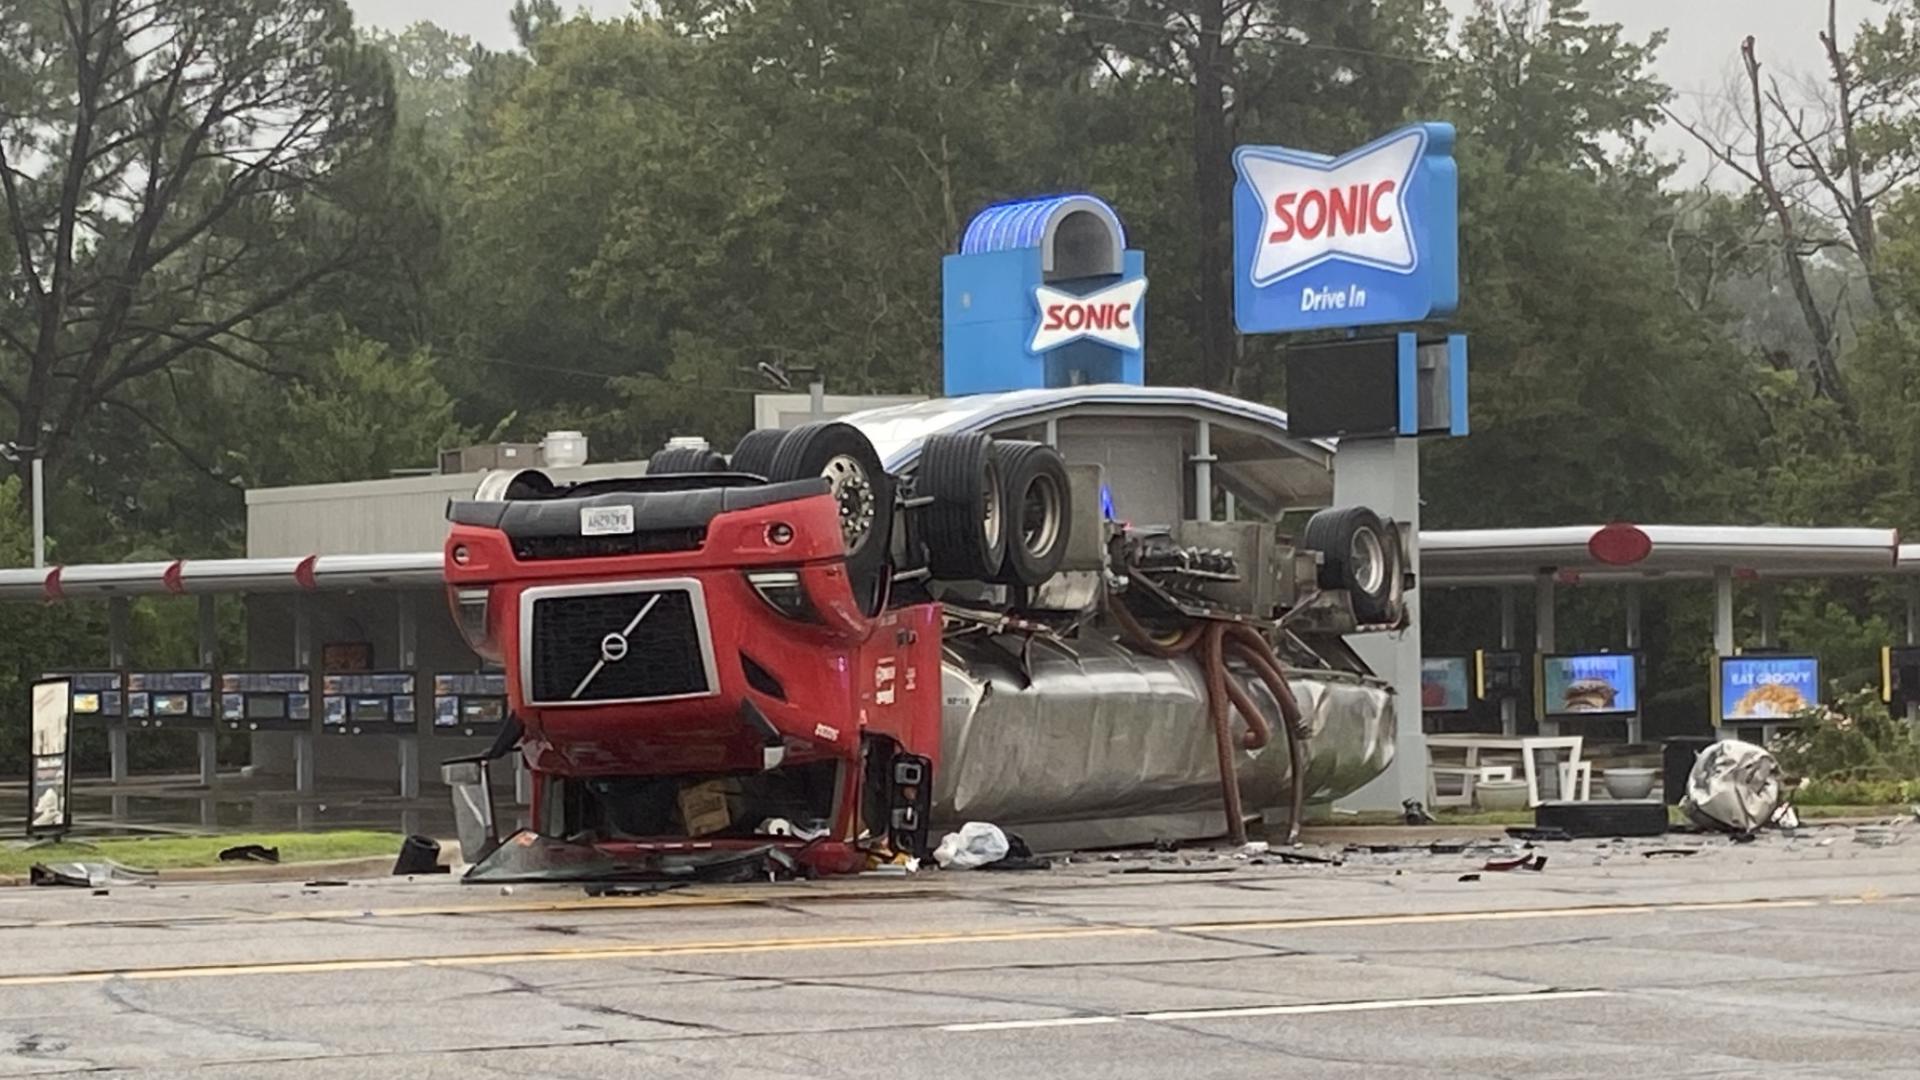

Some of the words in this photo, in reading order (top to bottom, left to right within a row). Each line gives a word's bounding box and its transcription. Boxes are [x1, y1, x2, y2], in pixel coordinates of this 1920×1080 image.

[1268, 180, 1396, 244] SONIC
[1301, 286, 1345, 311] Drive
[1349, 284, 1366, 308] In
[1043, 303, 1131, 331] SONIC
[1731, 673, 1754, 686] EAT
[1756, 671, 1811, 685] GROOVY
